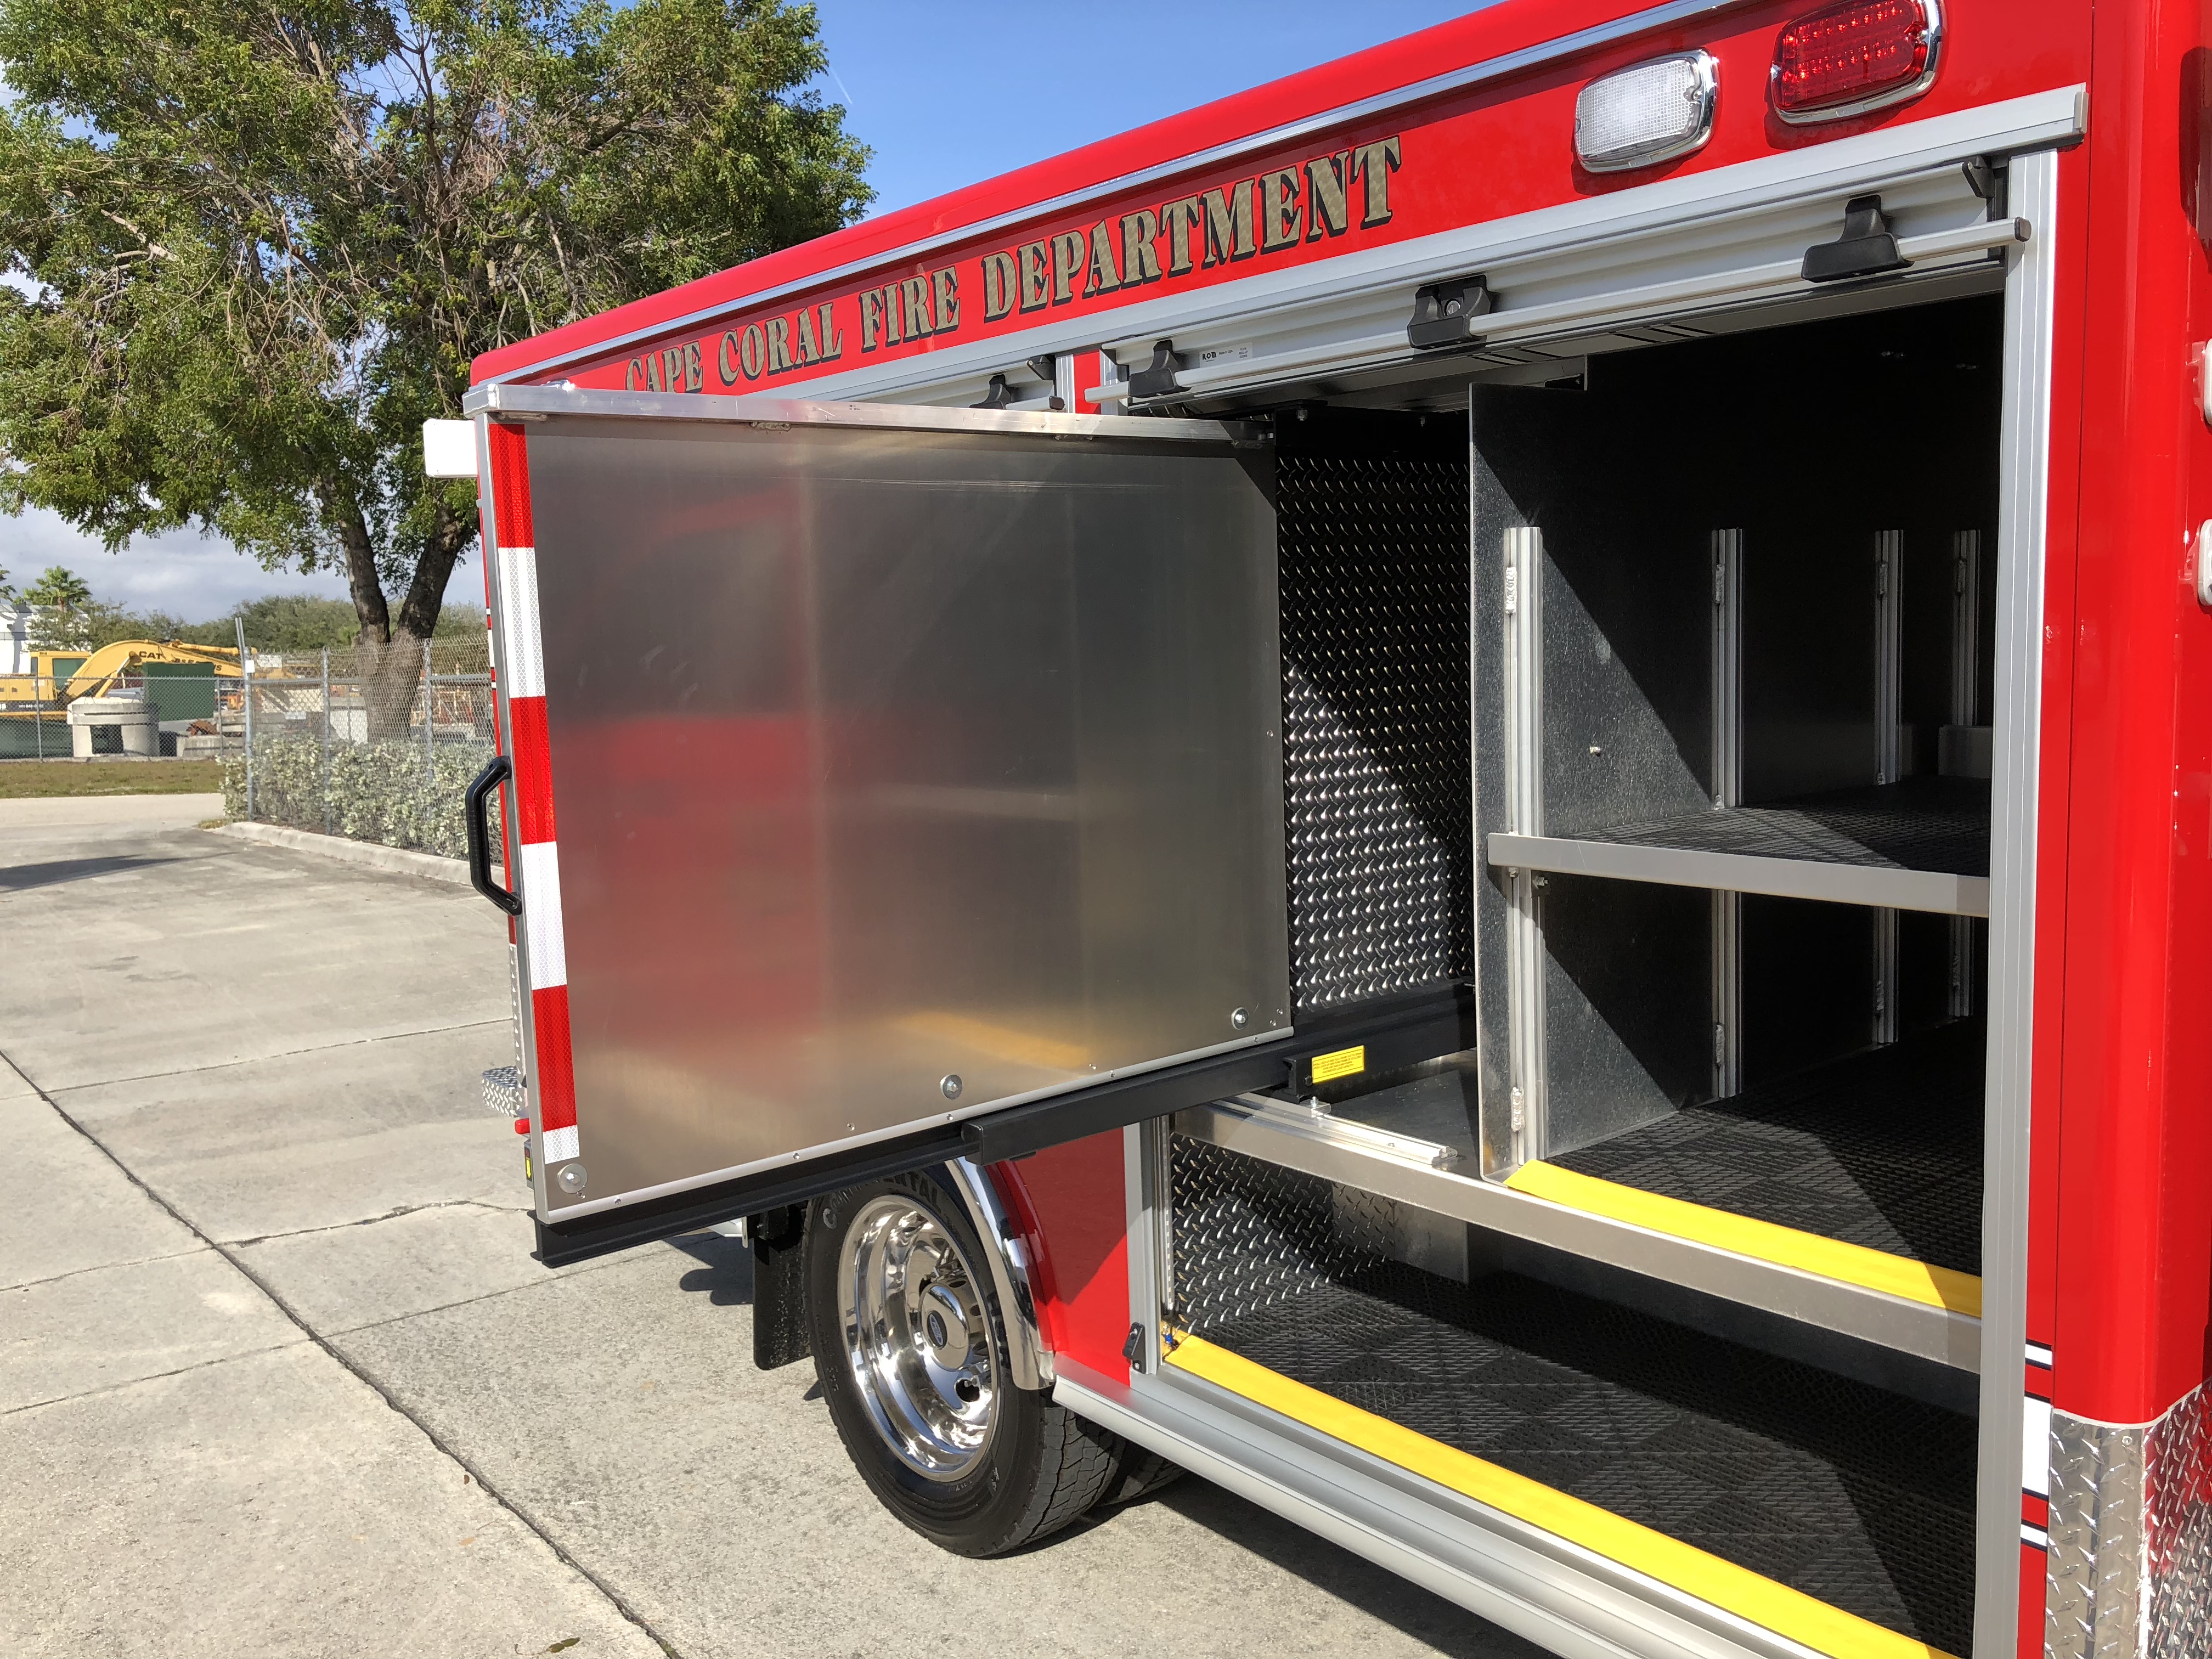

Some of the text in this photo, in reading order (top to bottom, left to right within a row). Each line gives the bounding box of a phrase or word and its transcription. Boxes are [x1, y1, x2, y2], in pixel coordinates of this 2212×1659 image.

[625, 135, 1402, 393] CAPE CORAL FIRE DEPARTMENT
[139, 651, 163, 660] CAT
